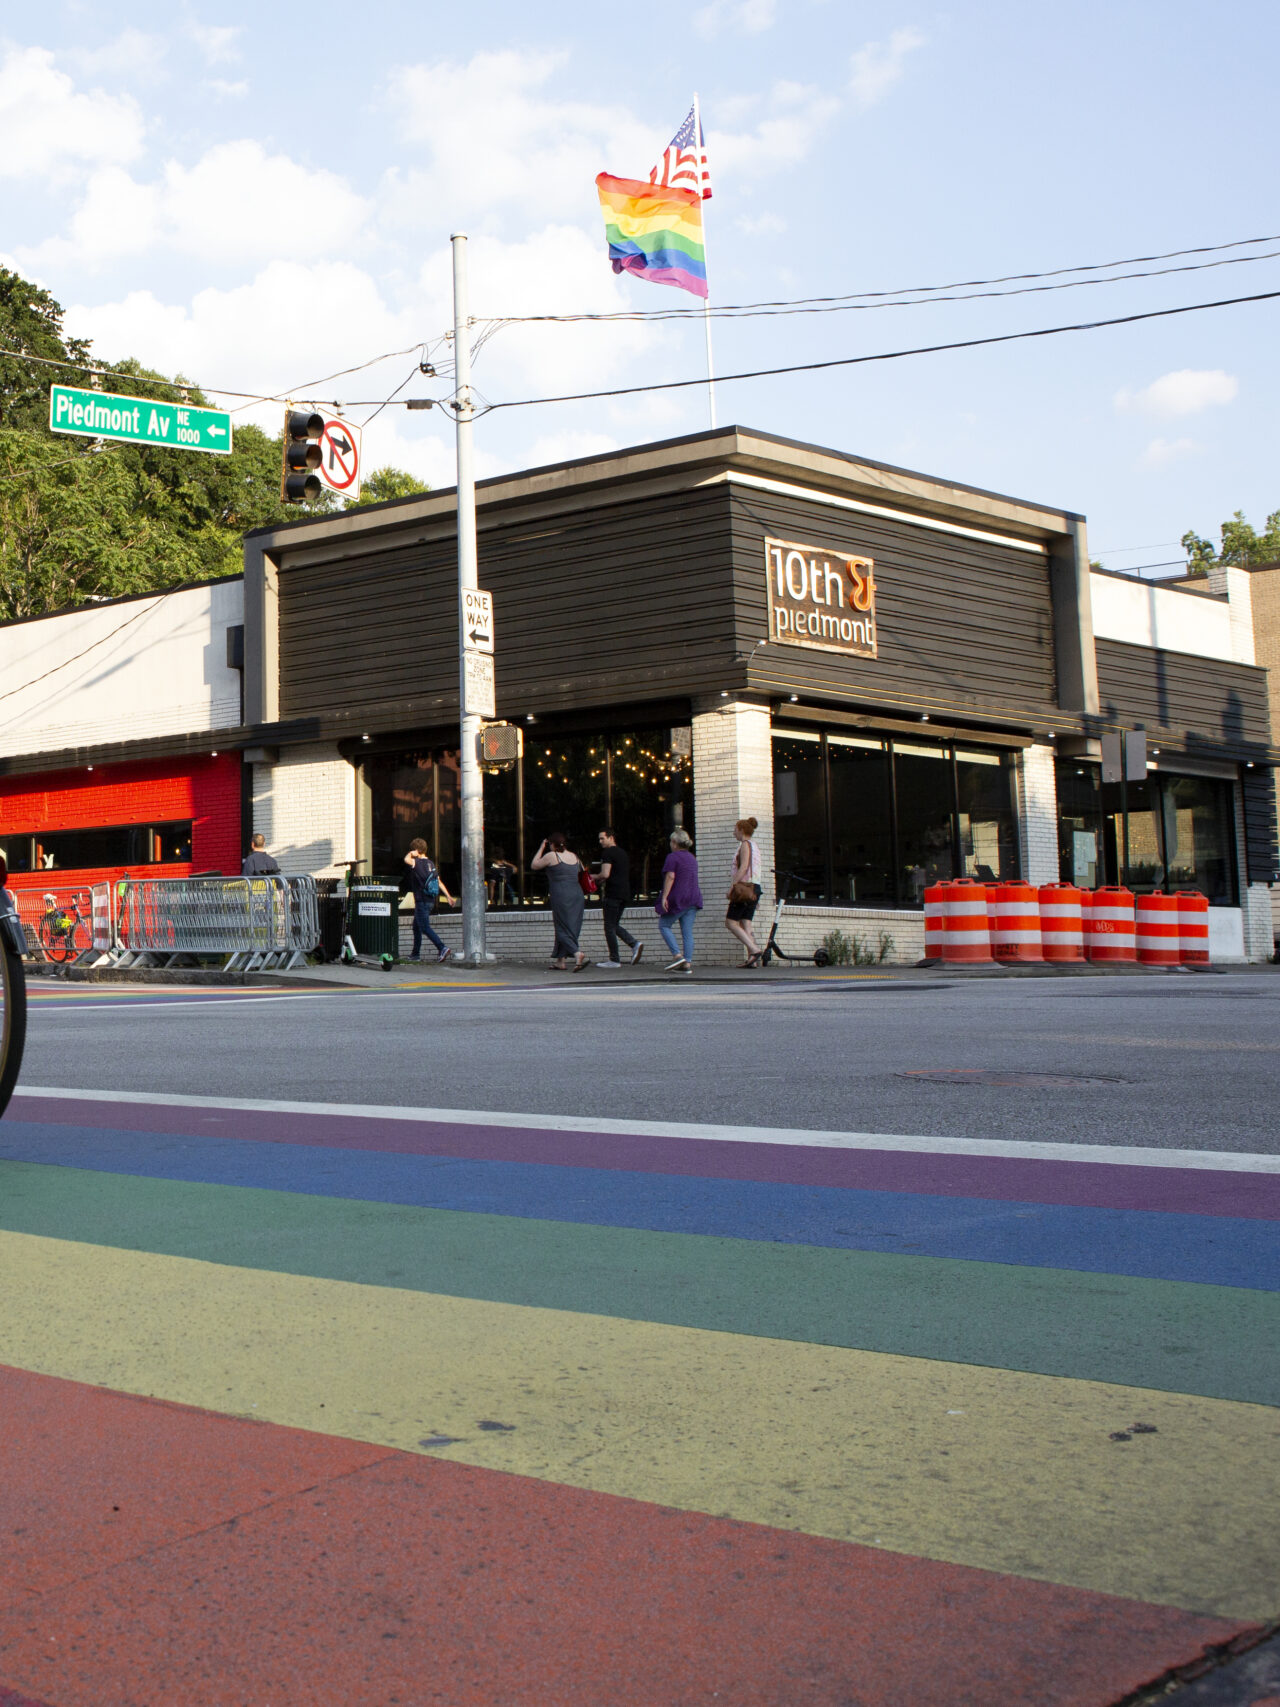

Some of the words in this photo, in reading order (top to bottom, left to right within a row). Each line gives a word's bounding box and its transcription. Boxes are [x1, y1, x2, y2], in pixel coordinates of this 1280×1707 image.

[56, 394, 140, 434] Piedmont
[147, 409, 170, 438] Av
[177, 410, 190, 427] NE
[177, 427, 201, 445] 1000
[770, 548, 844, 608] 10th
[466, 593, 489, 611] ONE
[467, 611, 489, 628] WAY
[773, 606, 875, 645] piedmont
